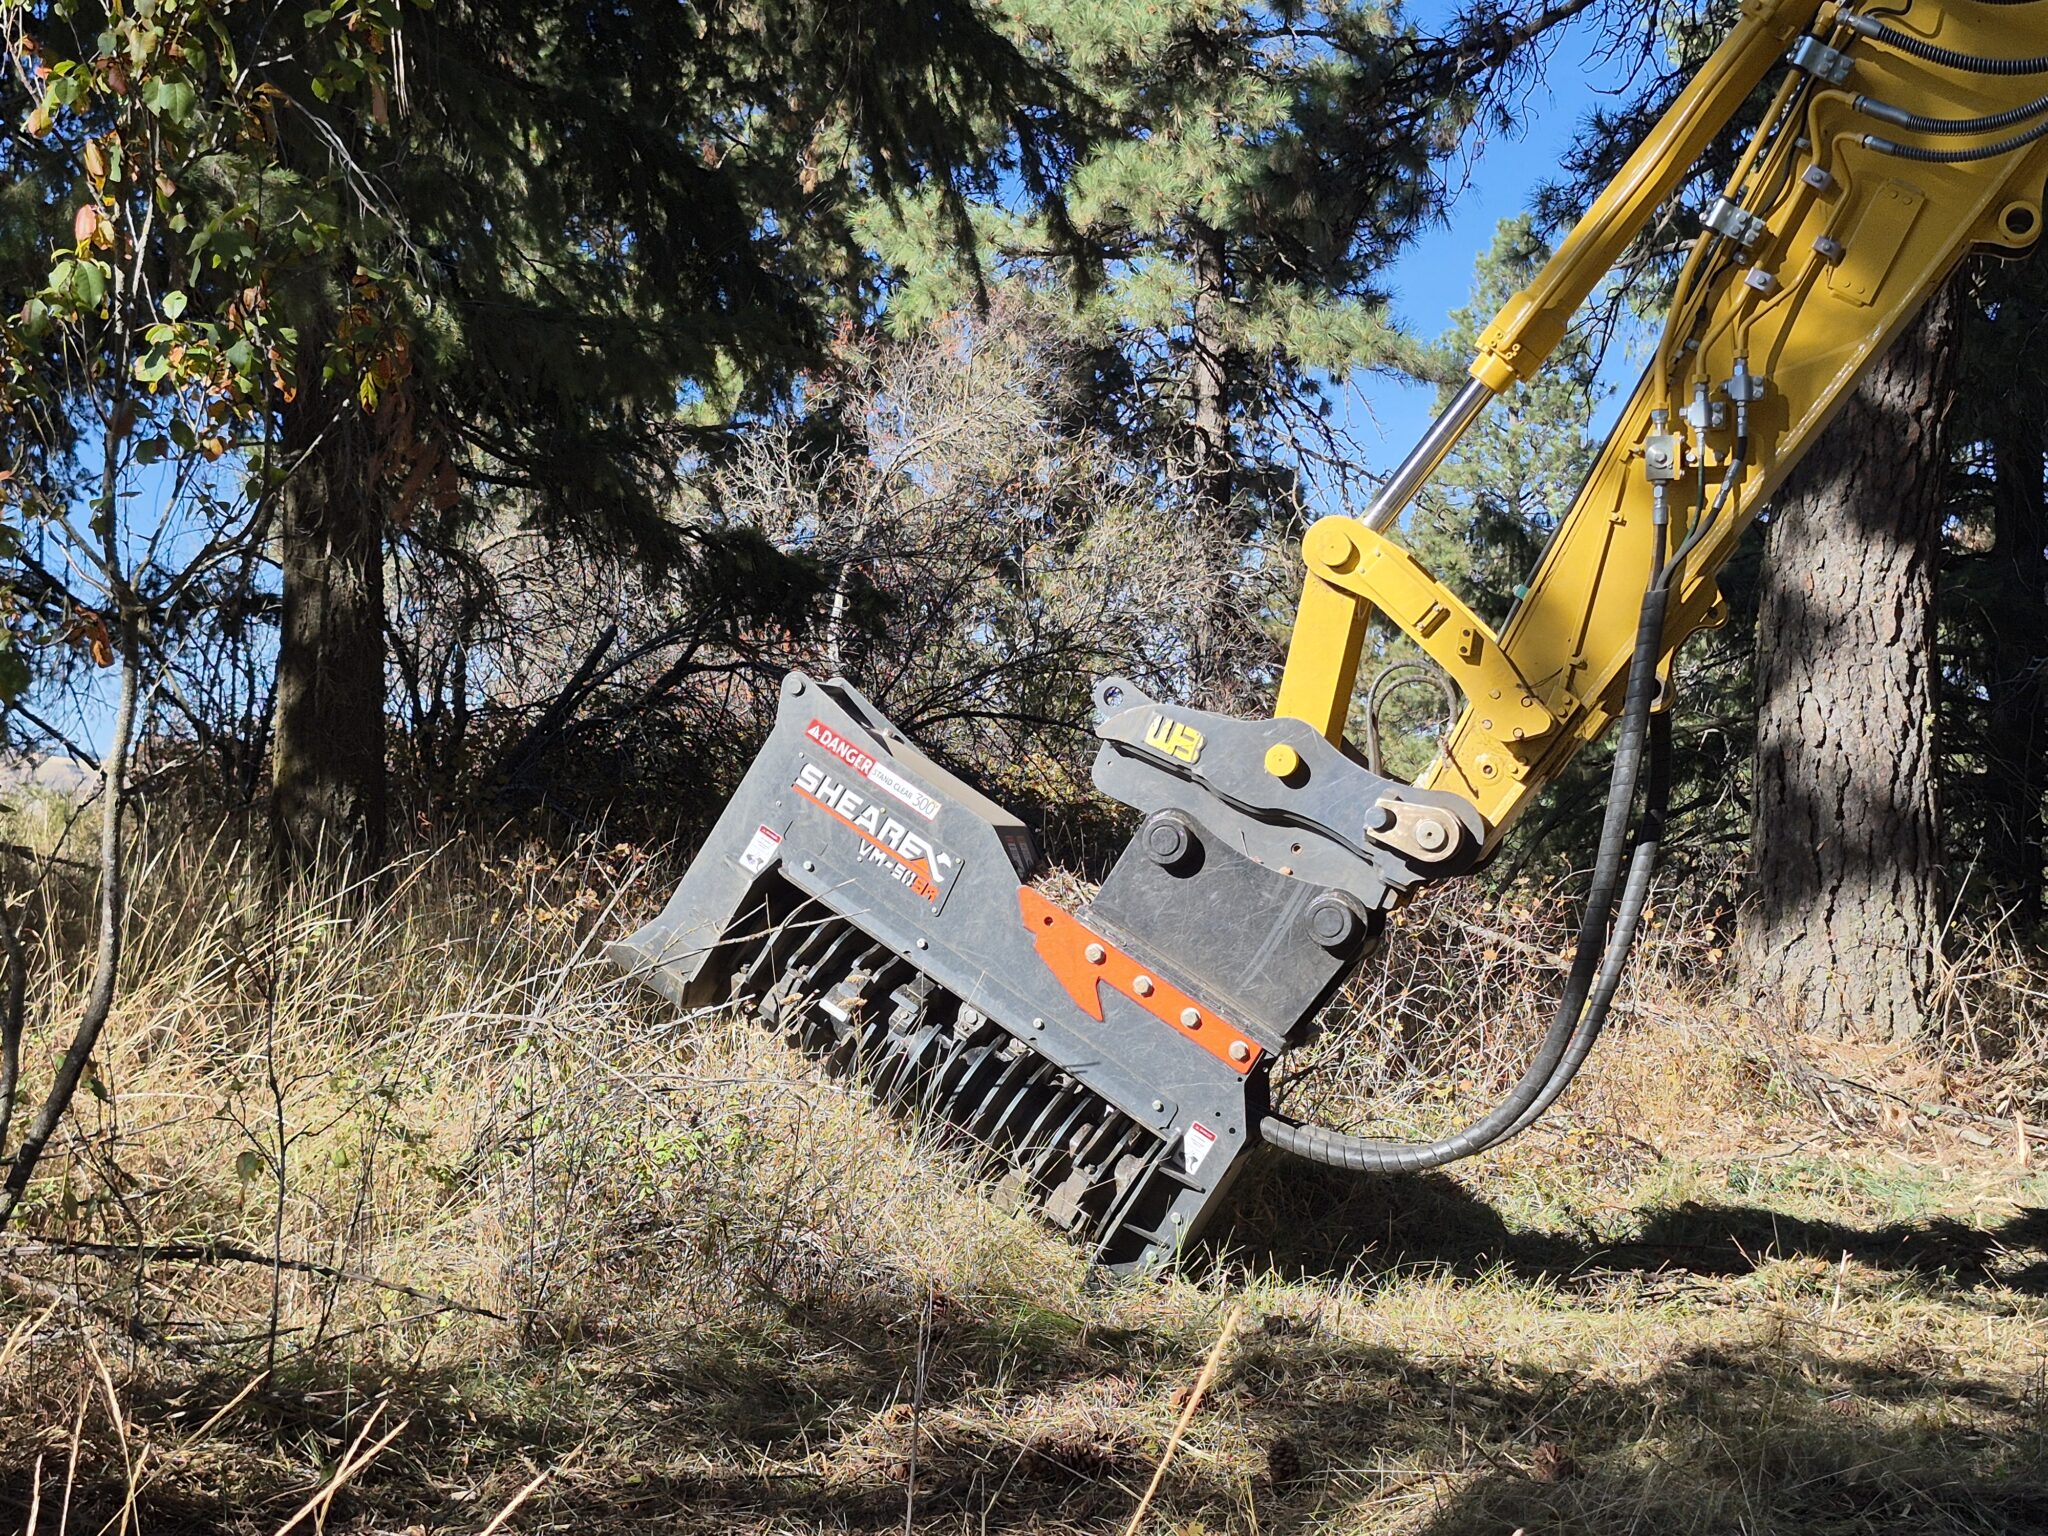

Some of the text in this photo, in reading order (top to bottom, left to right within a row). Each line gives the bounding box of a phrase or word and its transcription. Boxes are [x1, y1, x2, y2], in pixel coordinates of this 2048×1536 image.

[820, 730, 874, 773] DANGER
[872, 769, 893, 786] STAND
[893, 783, 913, 799] CLEAR
[794, 762, 951, 883] SHEAREX
